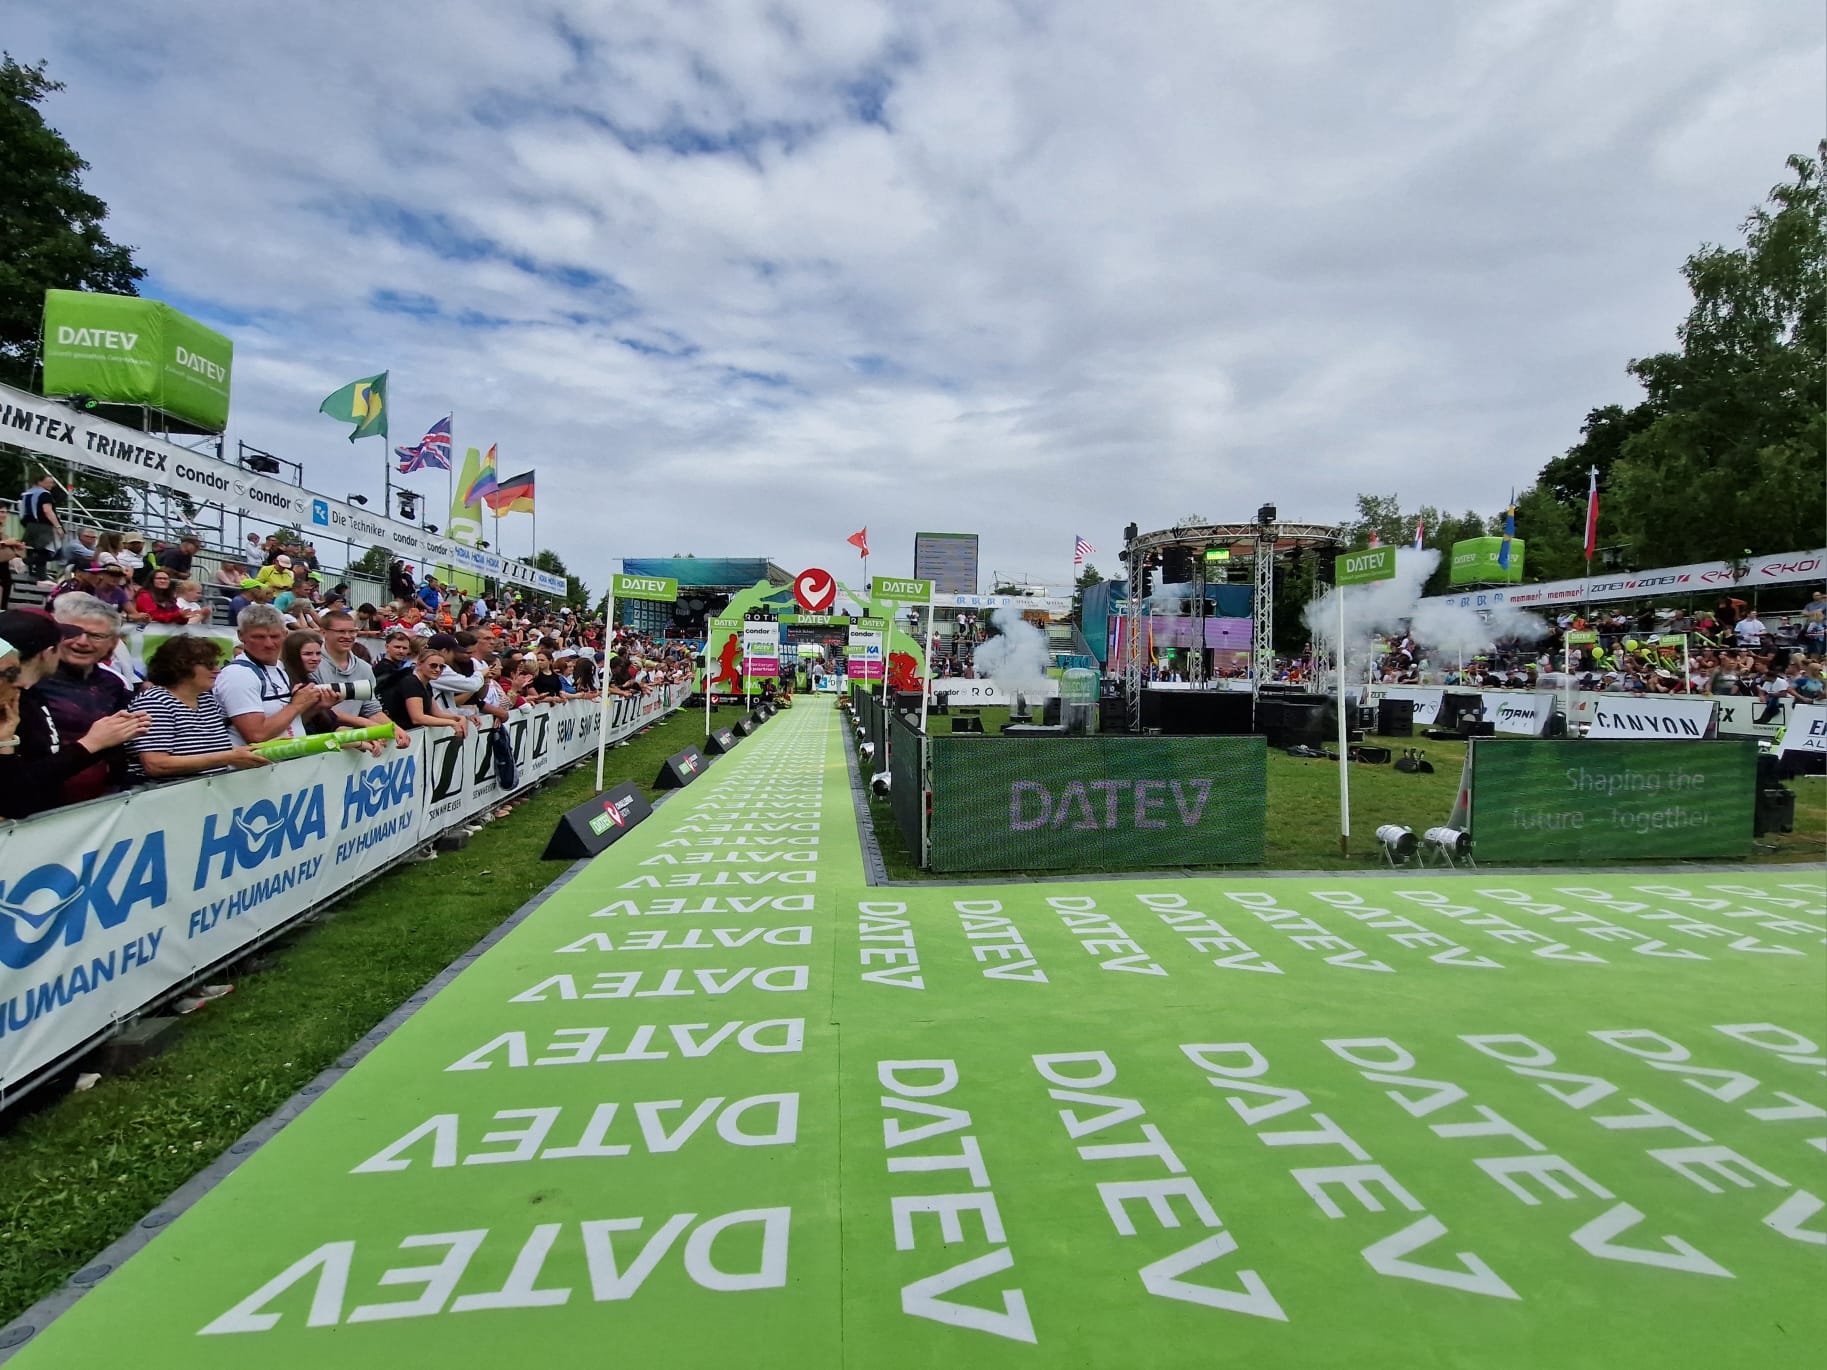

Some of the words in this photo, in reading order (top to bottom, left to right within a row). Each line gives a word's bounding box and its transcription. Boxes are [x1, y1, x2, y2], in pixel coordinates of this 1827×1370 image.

[57, 325, 139, 351] DATEV
[175, 345, 227, 384] DATEV
[0, 402, 76, 445] IMTEX
[86, 431, 168, 473] TRIMTEX
[175, 463, 230, 492] condor
[248, 486, 291, 510] condor
[331, 509, 346, 527] Die
[348, 514, 386, 538] Techniker
[393, 531, 418, 548] condor
[427, 541, 448, 555] condor
[1346, 551, 1385, 574] DATEV
[1454, 553, 1477, 564] DATEV
[621, 577, 666, 593] DATEV
[882, 581, 924, 595] DATEV
[1510, 589, 1543, 603] memmert
[1547, 584, 1585, 600] memmert
[1591, 580, 1624, 593] ZONE3
[1637, 575, 1675, 588] ZONE3
[714, 619, 738, 627] DATEV
[745, 613, 778, 621] ROTH
[797, 615, 831, 625] DATEV
[862, 619, 885, 628] DATEV
[933, 688, 960, 697] condor
[1596, 711, 1700, 737] CANYON
[341, 755, 417, 830] HOKA
[1566, 766, 1661, 796] Shaping
[1669, 766, 1705, 791] the
[1009, 778, 1214, 832] DATEV
[1611, 805, 1709, 834] together
[193, 783, 326, 892] HOKA
[336, 840, 356, 865] FLY
[356, 822, 398, 854] HUMAN
[398, 810, 413, 832] FLY
[656, 835, 820, 848] DATEV
[670, 822, 821, 834] DATEV
[616, 869, 817, 890] DATEV
[639, 850, 819, 867] DATEV
[0, 829, 168, 970] OKA
[188, 898, 226, 939] FLY
[227, 865, 296, 920] HUMAN
[296, 853, 324, 887] FLY
[589, 894, 815, 918] DATEV
[1630, 885, 1827, 945] DATE
[552, 926, 813, 954] DATEV
[953, 899, 1050, 984] DATEV
[1046, 896, 1169, 977] DATEV
[1136, 893, 1285, 975] DATEV
[1224, 891, 1394, 973] DATEV
[1311, 891, 1502, 969] DATEV
[1395, 890, 1607, 965] DATEV
[1476, 888, 1710, 961] DATEV
[1554, 886, 1807, 957] DATEV
[121, 928, 163, 975] FLY
[859, 901, 925, 991] DATEV
[508, 965, 810, 1003] DATEV
[445, 1018, 805, 1072] DATEV
[351, 1093, 800, 1174] DATEV
[1179, 1041, 1521, 1300] DATEV
[1322, 1036, 1734, 1279] DATEV
[878, 1059, 1038, 1345] DATEV
[1032, 1050, 1288, 1322] DATEV
[198, 1207, 792, 1336] DATEV
